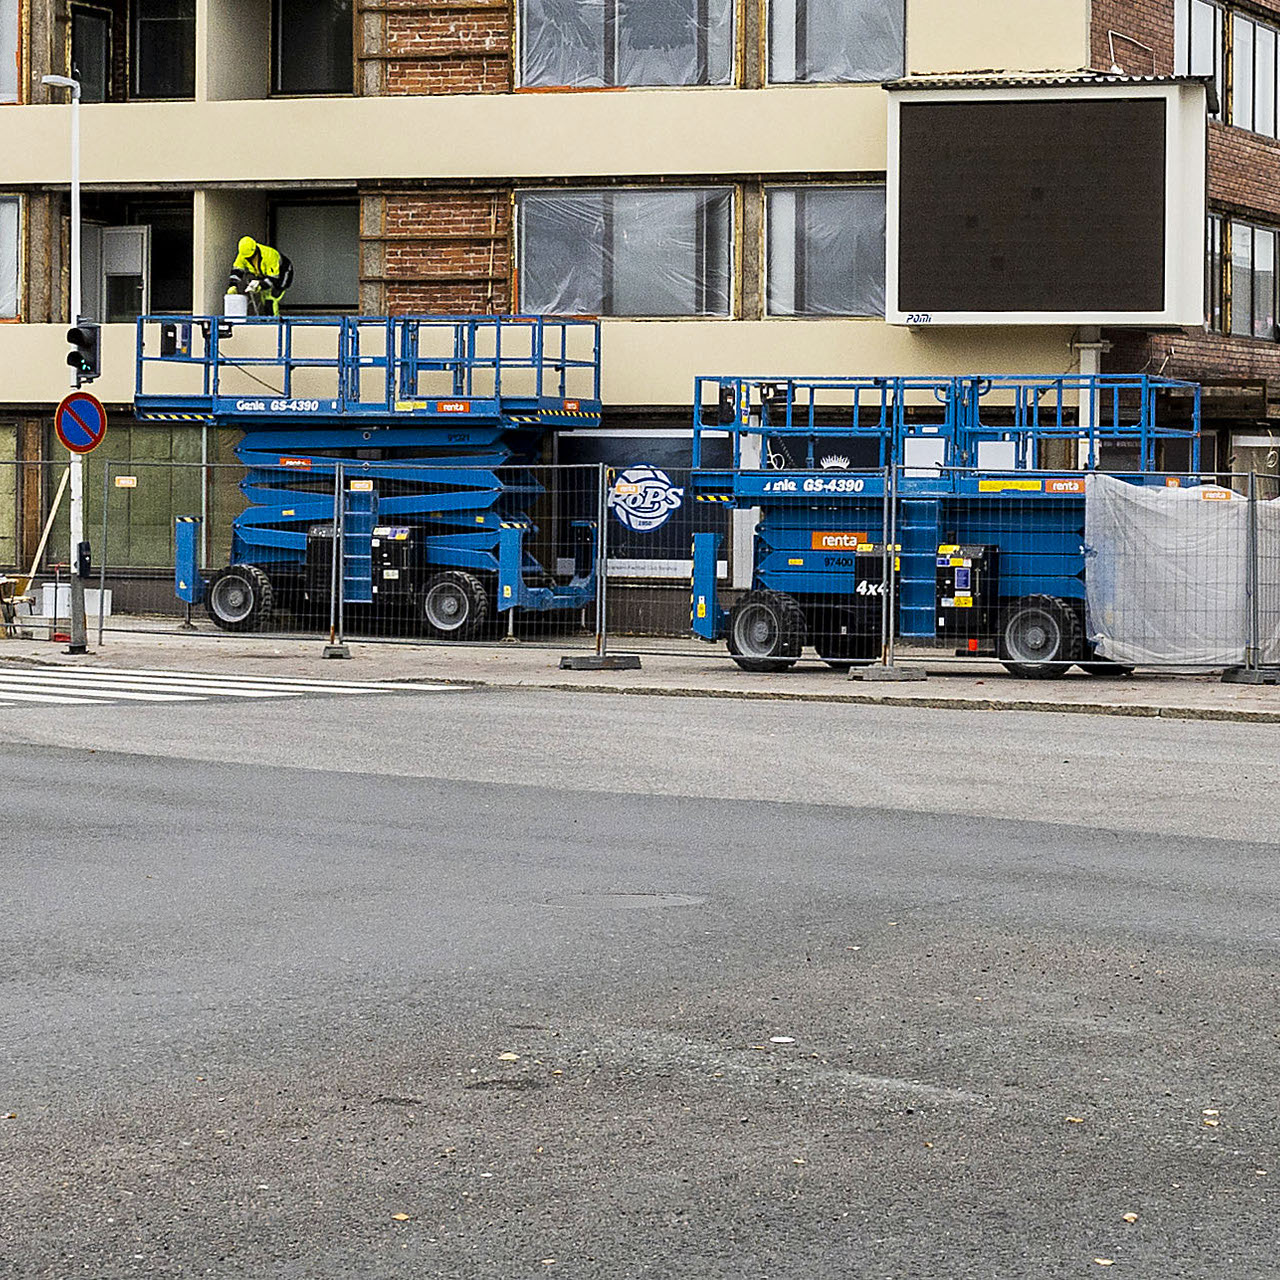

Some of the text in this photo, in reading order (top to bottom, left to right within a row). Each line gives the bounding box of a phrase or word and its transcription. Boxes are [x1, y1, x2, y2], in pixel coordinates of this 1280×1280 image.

[236, 400, 319, 411] Genie GS-4390
[443, 403, 464, 411] renta
[803, 479, 864, 492] GS-4390
[1053, 481, 1079, 491] renta
[822, 534, 857, 546] renta
[824, 557, 853, 567] 97400
